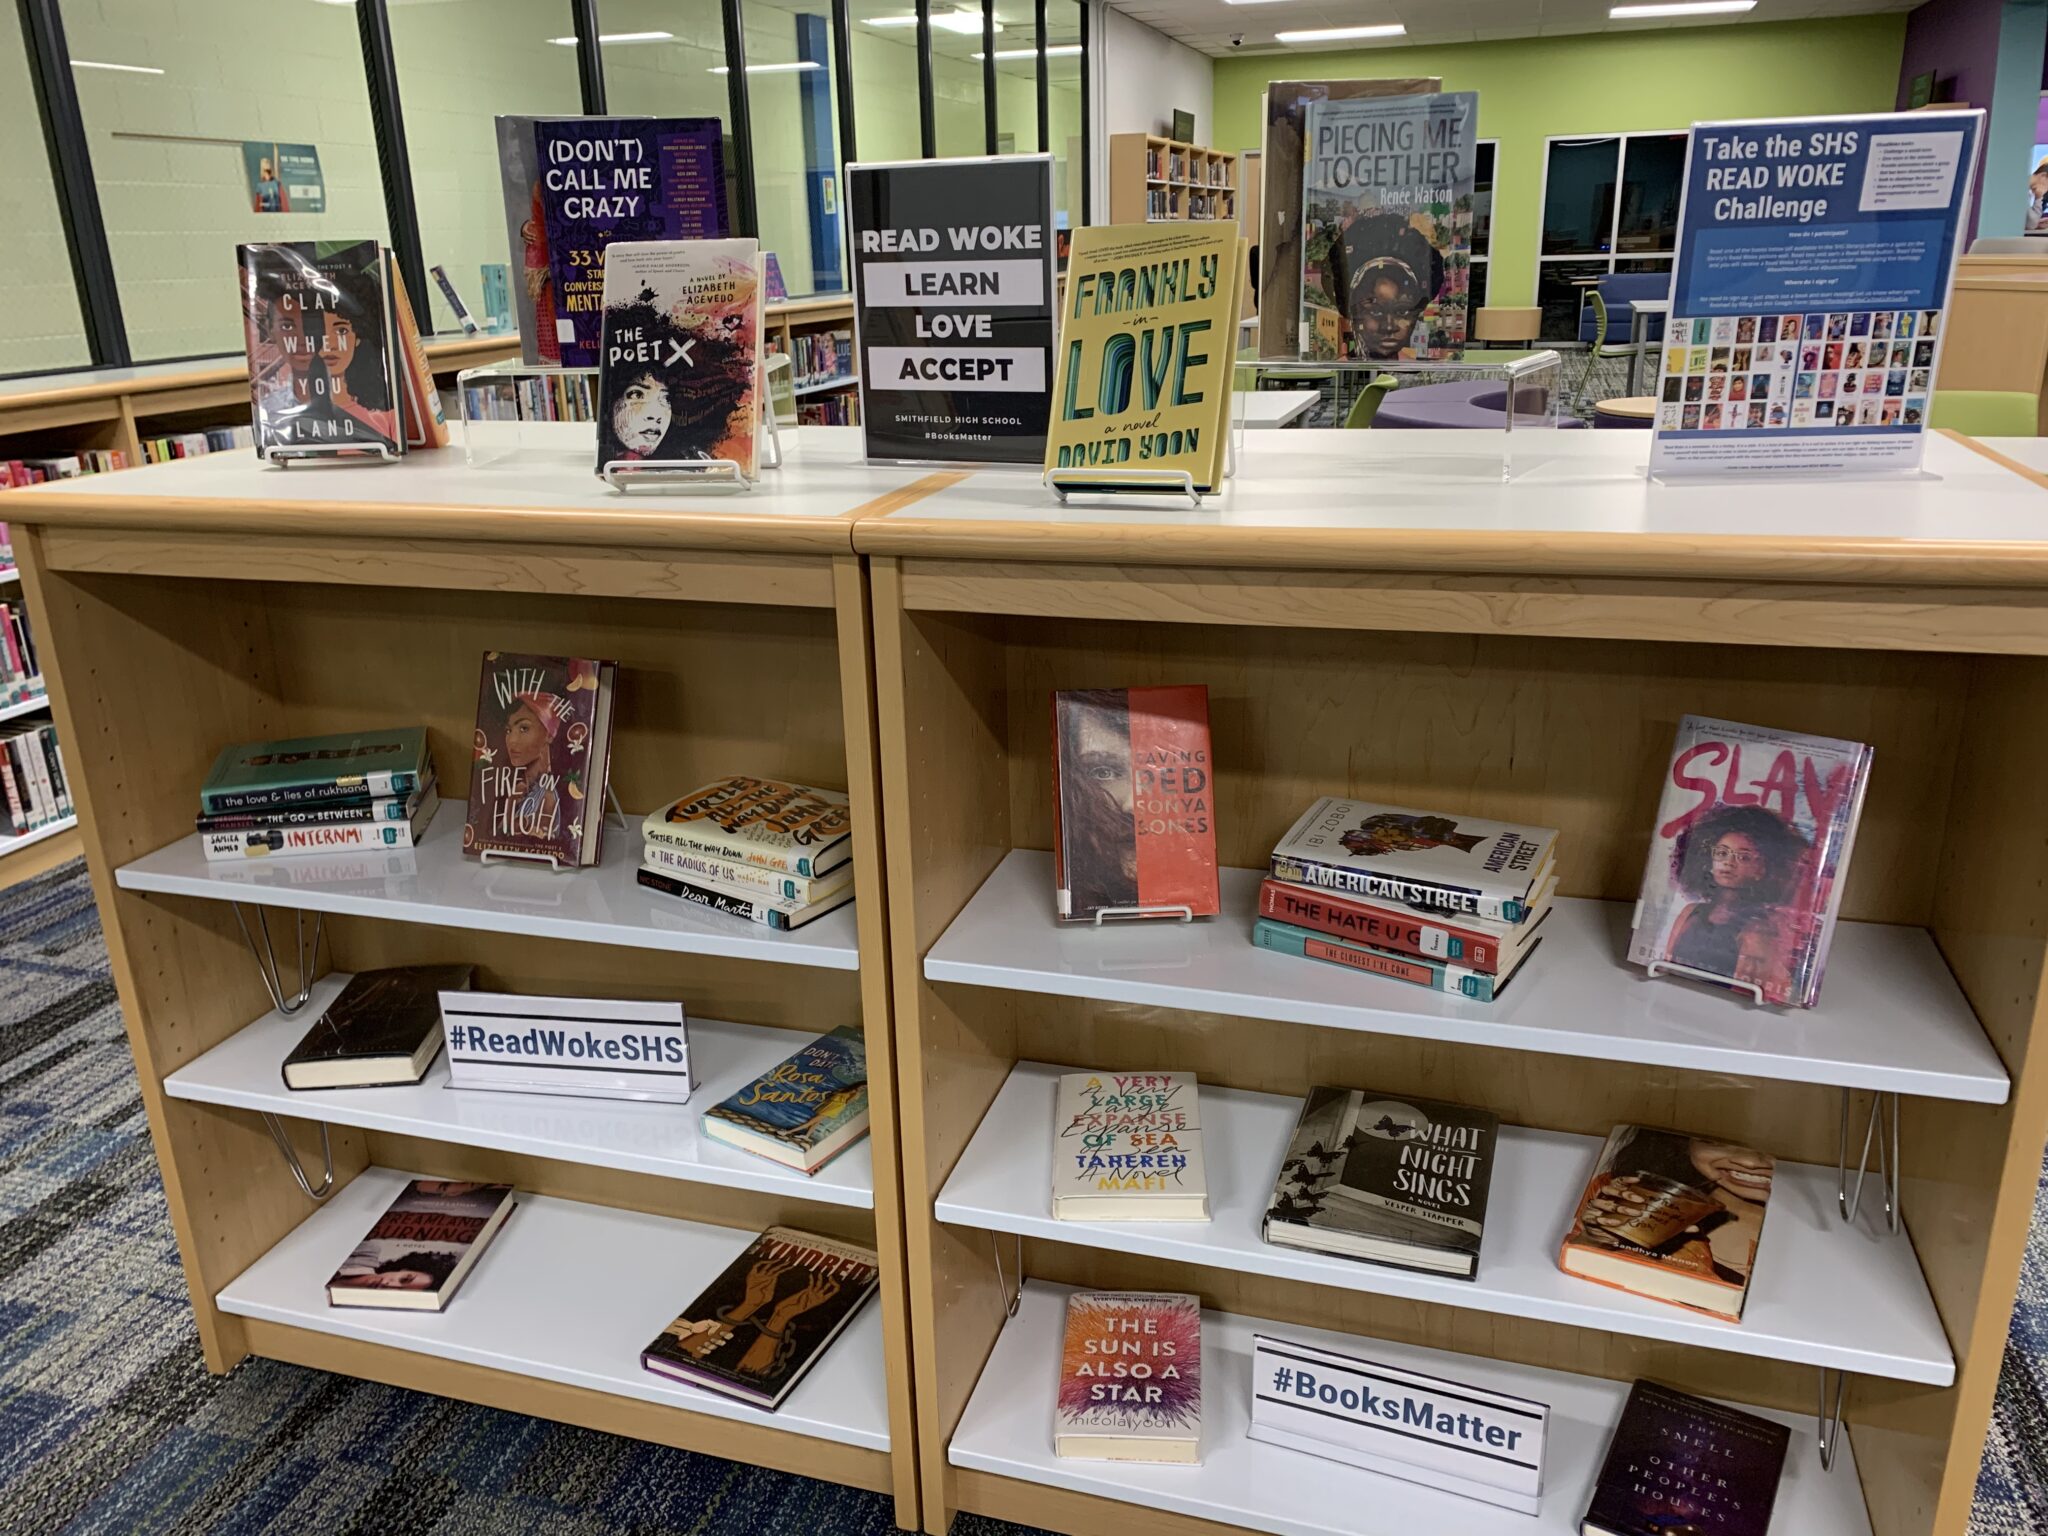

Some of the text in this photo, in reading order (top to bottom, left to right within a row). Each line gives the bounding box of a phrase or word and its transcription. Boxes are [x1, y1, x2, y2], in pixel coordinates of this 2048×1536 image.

[1318, 117, 1463, 156] PIECING ME
[1703, 131, 1859, 161] Take the SHS
[548, 137, 644, 165] (DON'T)
[545, 167, 652, 192] CALL ME
[1319, 151, 1461, 190] TOGETHER
[1706, 166, 1770, 191] READ
[1777, 162, 1847, 189] WOKE
[563, 196, 640, 220] CRAZY
[1380, 187, 1453, 206] Renée Watson
[1714, 195, 1828, 223] Challenge
[862, 224, 1042, 253] READ WOKE
[569, 250, 591, 266] 33
[683, 281, 736, 295] ELIZABETH
[905, 271, 1000, 297] LEARN
[1074, 253, 1219, 320] FRANKLY
[283, 293, 341, 310] CLAP
[686, 293, 734, 305] ACEVEDO
[615, 326, 644, 344] THE
[915, 313, 993, 339] LOVE
[283, 335, 348, 353] WHEN
[663, 336, 697, 369] X
[898, 357, 1014, 382] ACCEPT
[1062, 319, 1213, 422] LOVE
[298, 377, 342, 396] YOU
[296, 419, 354, 438] LAND
[895, 414, 1022, 425] SMITHFIELD HIGH SCHOOL
[1104, 412, 1162, 434] a novel
[925, 431, 992, 442] #BooksMatter
[1057, 427, 1200, 468] DAVID YOON
[493, 668, 546, 709] WITH
[550, 694, 576, 723] THE
[481, 766, 560, 805] FIRE ON
[1135, 767, 1206, 797] RED
[1660, 741, 1850, 840] SLAY
[225, 784, 369, 808] the love & lies of rukhsana
[1136, 798, 1207, 815] SONYA
[267, 814, 284, 823] THE
[492, 797, 560, 841] HIGH
[1137, 817, 1208, 836] SONES
[1306, 802, 1354, 849] IBI ZOBOI
[211, 834, 239, 844] SAMIRA
[213, 844, 239, 853] AHMED
[287, 828, 363, 848] INTERNM
[648, 830, 768, 866] TURTLES ALL THE WAY DOWN JOHN
[659, 850, 735, 881] THE RADIUS OF US
[1482, 832, 1522, 874] AMERICAN
[1508, 840, 1541, 872] STREET
[1305, 863, 1405, 900] AMERICAN
[681, 885, 754, 919] Dear Martin
[1284, 897, 1321, 922] THE
[1328, 908, 1380, 934] HATE
[1385, 924, 1401, 939] U
[1325, 947, 1410, 978] THE CLOSEST I'VE COME
[450, 1024, 684, 1064] #ReadWokeSHS
[803, 1047, 841, 1062] DON'T
[763, 1064, 826, 1087] Rosa
[1086, 1076, 1173, 1088] A VERY
[739, 1081, 832, 1109] Santos
[1090, 1094, 1167, 1107] LARGE
[1119, 1084, 1184, 1102] Very
[1073, 1113, 1187, 1128] EXPANSE
[1083, 1133, 1178, 1147] OF SEA
[1409, 1119, 1487, 1151] WHAT
[1075, 1155, 1187, 1169] TAHEREH
[1109, 1164, 1184, 1185] Novel
[1400, 1145, 1482, 1180] NIGHT
[1097, 1177, 1166, 1191] MAFI
[1393, 1168, 1471, 1207] SINGS
[1385, 1199, 1465, 1227] VESPER STAMPER
[1418, 1198, 1441, 1210] NOVEL
[758, 1238, 876, 1281] KINDRED
[1613, 1241, 1699, 1267] Sandhya Menon
[1105, 1318, 1158, 1335] THE
[1084, 1339, 1177, 1356] SUN IS
[1075, 1362, 1181, 1380] ALSO A
[1091, 1384, 1163, 1403] STAR
[1273, 1366, 1522, 1451] #BooksMatter
[1073, 1415, 1177, 1432] nicola yoon
[1688, 1423, 1716, 1437] THE
[1661, 1427, 1735, 1459] SMELL
[1649, 1455, 1729, 1489] OTHER
[1628, 1464, 1742, 1511] PEOPLE'S
[1634, 1483, 1726, 1523] HOUSES
